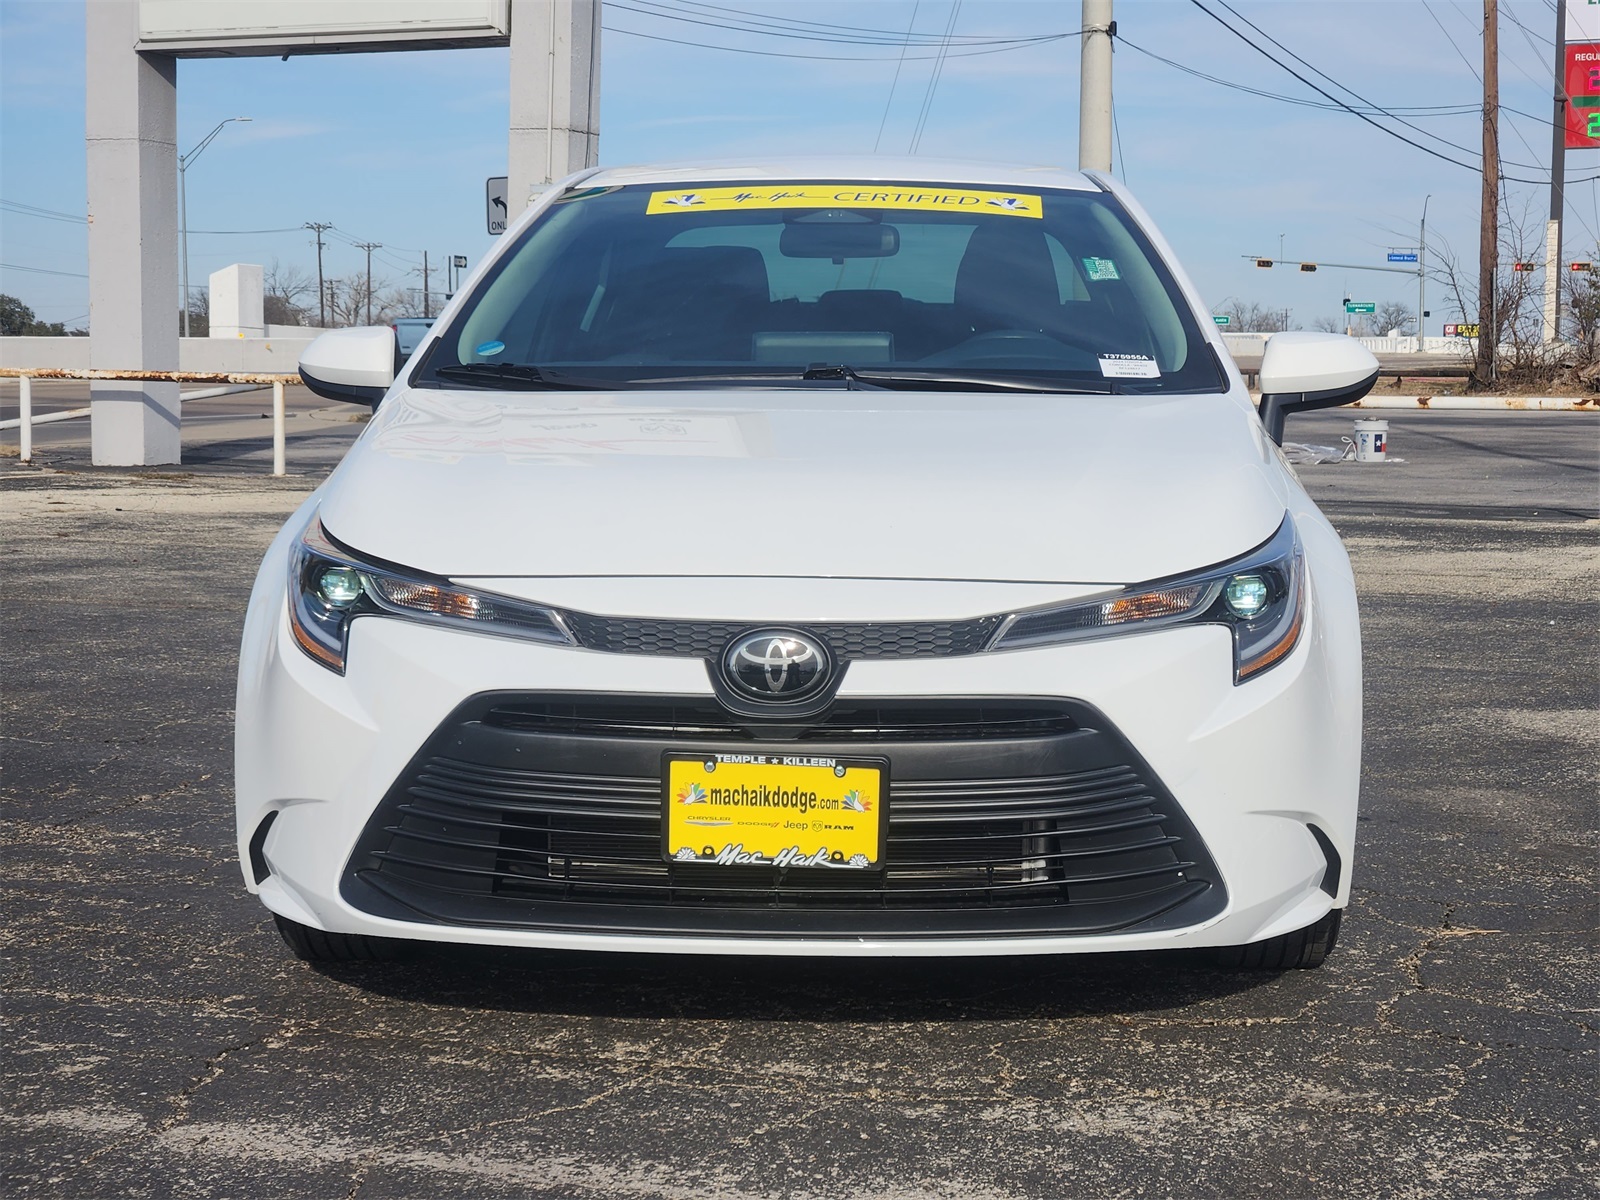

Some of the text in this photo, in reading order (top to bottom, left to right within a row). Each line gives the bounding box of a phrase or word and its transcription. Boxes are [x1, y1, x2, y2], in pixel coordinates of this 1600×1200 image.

[833, 192, 980, 206] CERTIFIED
[715, 754, 836, 768] TEMPLE KILLEEN
[709, 784, 839, 814] machaikdodge.com
[783, 820, 808, 831] Jeep
[703, 842, 838, 868] Mac Haik
